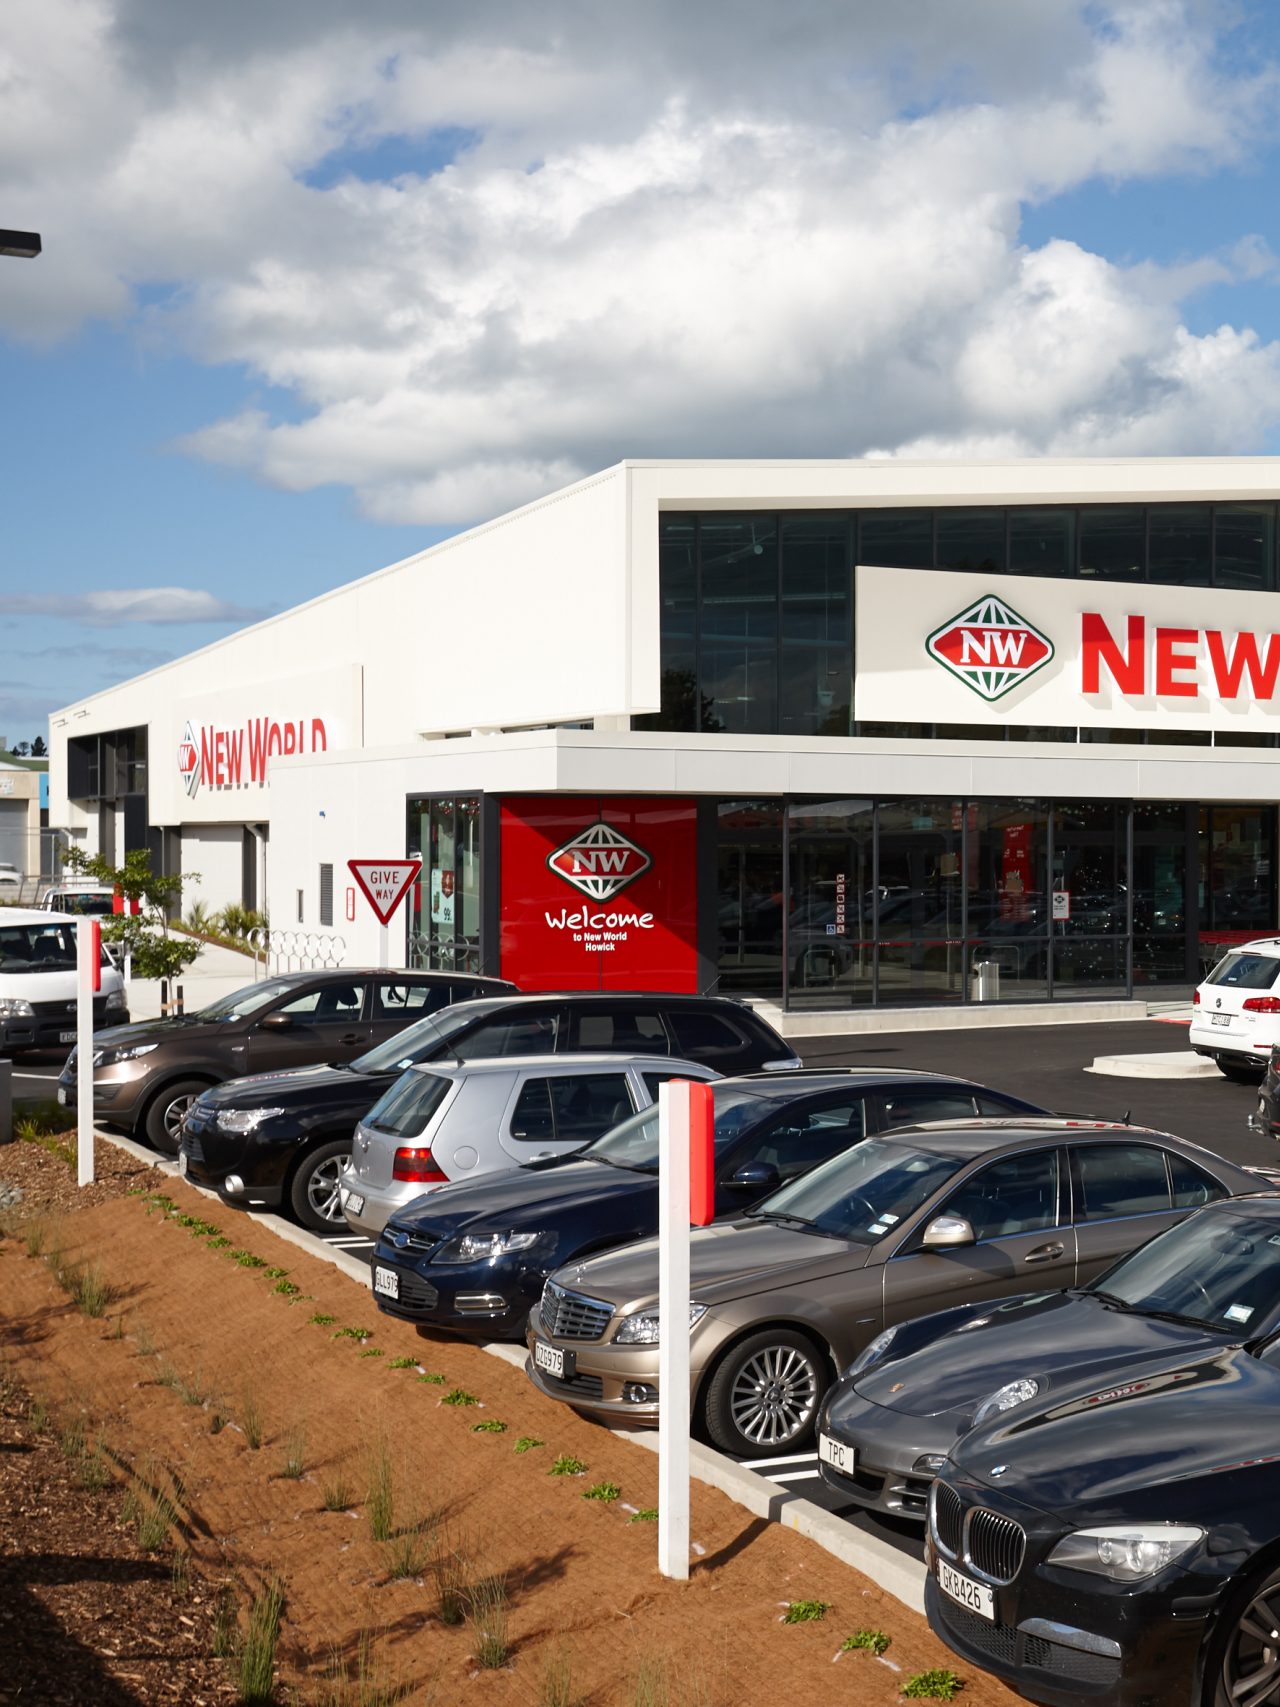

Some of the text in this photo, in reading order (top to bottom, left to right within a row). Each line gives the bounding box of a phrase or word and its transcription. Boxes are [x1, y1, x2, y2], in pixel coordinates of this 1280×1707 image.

[960, 629, 1028, 666] NW
[201, 724, 244, 787] NEW
[572, 851, 630, 873] NW
[370, 871, 400, 885] GIVE
[375, 889, 394, 900] WAY
[544, 905, 655, 930] Welcome
[573, 931, 628, 942] to New World
[585, 942, 616, 952] Howick
[828, 1440, 845, 1467] TPC
[942, 1564, 981, 1610] GKB426
